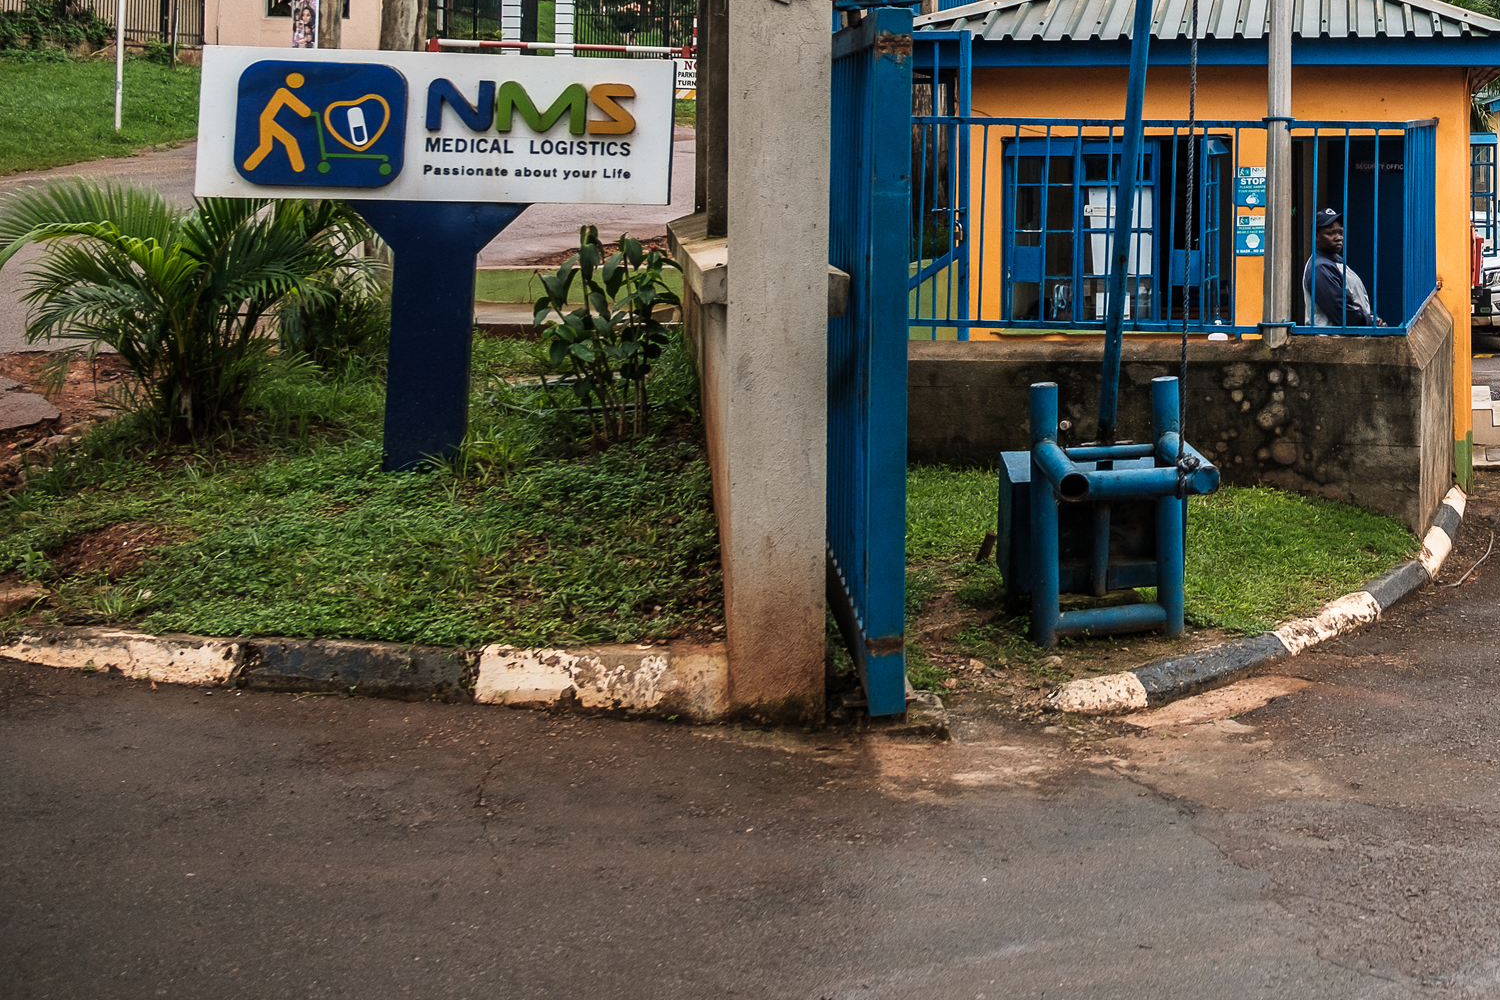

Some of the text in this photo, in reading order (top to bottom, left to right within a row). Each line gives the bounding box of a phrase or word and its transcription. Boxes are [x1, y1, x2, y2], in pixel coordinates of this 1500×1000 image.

[425, 78, 637, 135] NMS
[425, 137, 632, 157] MEDICAL LOGISTICS
[423, 164, 632, 180] Passionate about your Life
[1240, 177, 1266, 186] STOP
